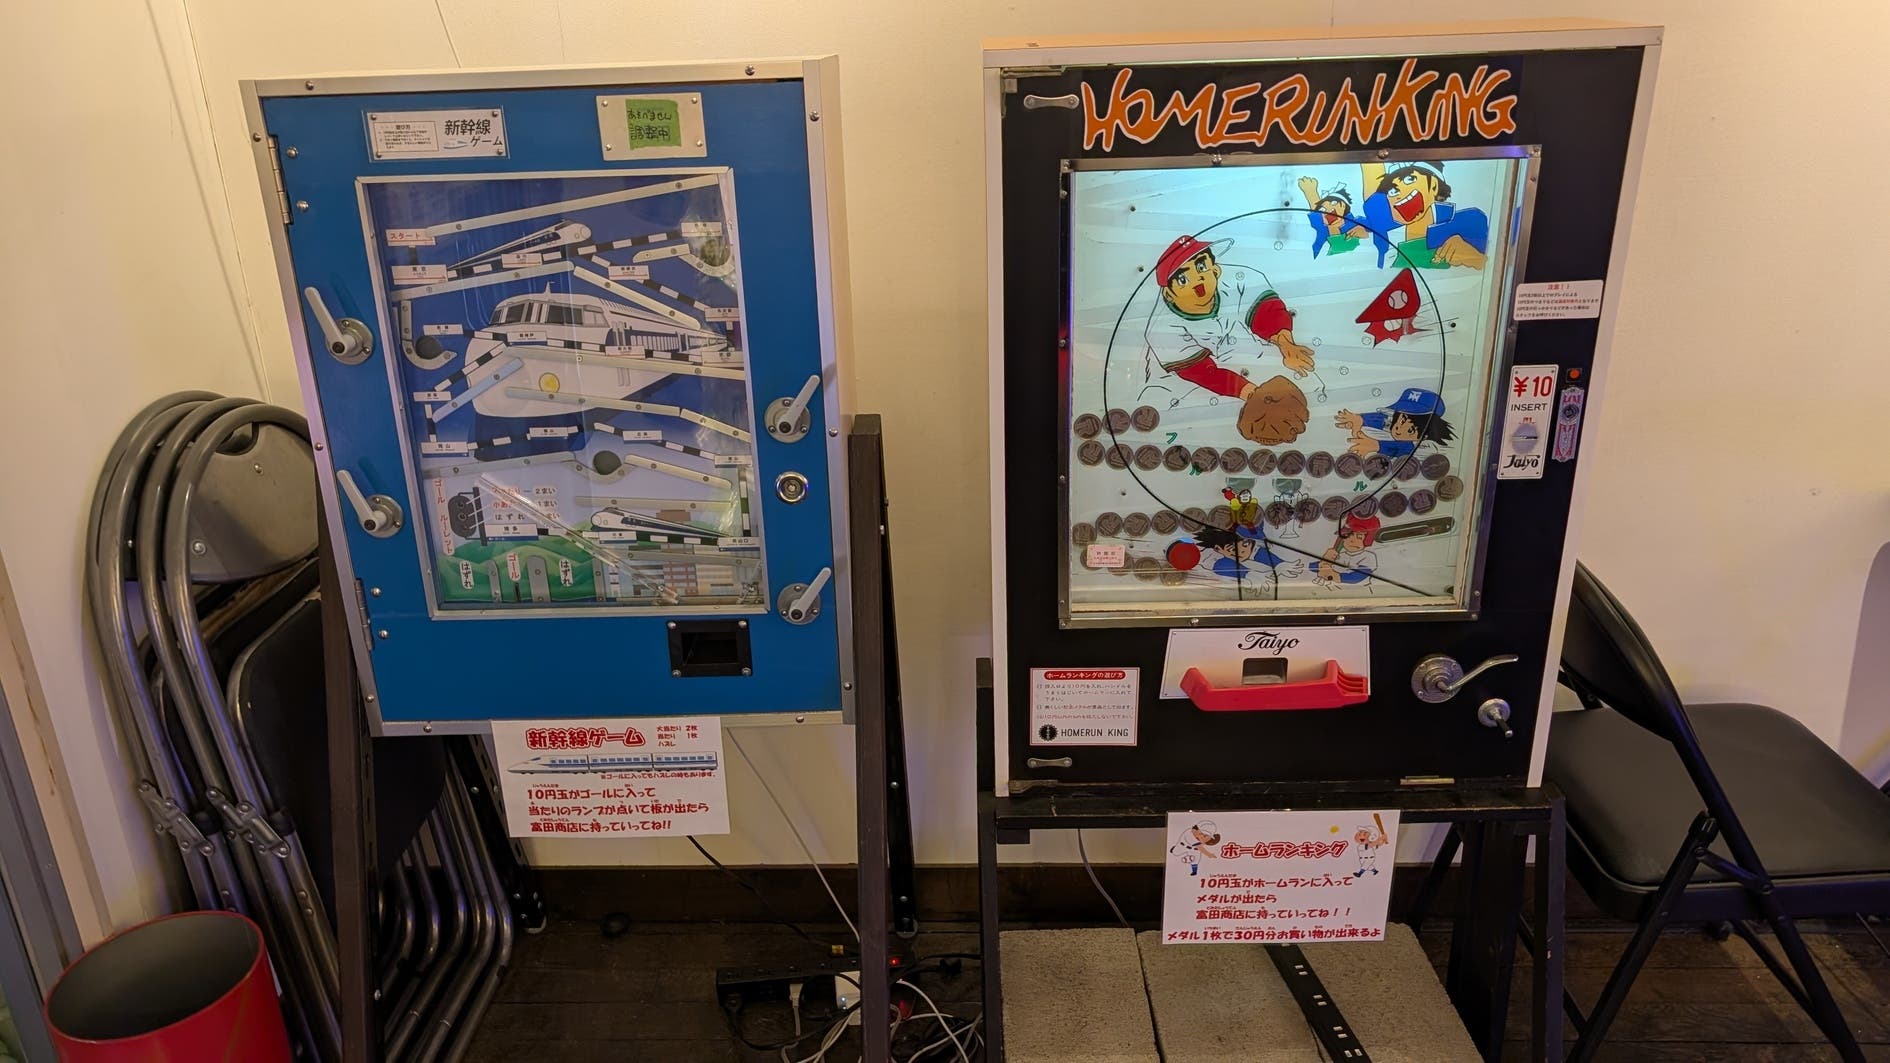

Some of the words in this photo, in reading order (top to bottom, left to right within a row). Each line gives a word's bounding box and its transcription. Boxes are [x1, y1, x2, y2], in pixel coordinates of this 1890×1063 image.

[444, 119, 491, 136] 新幹線
[470, 135, 503, 148] ゲーム
[390, 232, 421, 240] スタート
[1511, 403, 1548, 412] INSERT
[508, 553, 520, 579] ゴール
[561, 560, 572, 585] はずれ
[461, 563, 473, 588] はずれ
[1237, 631, 1300, 656] Taiyo
[685, 724, 698, 732] 2枚
[1061, 728, 1103, 737] HOMERUN
[1107, 728, 1129, 737] KING
[526, 727, 646, 750] 新幹線ゲーム
[687, 732, 698, 740] 1枚
[527, 787, 656, 800] 10円玉がゴールに入って
[528, 802, 710, 816] 当たりのランプが点いて板が出たら
[1220, 841, 1349, 860] ホームランキング
[1199, 876, 1354, 889] 10円玉がホームランに入って
[1196, 893, 1278, 904] メダルが出たら
[1167, 927, 1382, 941] メダル1枚で30円分お買い物が出来るよ
